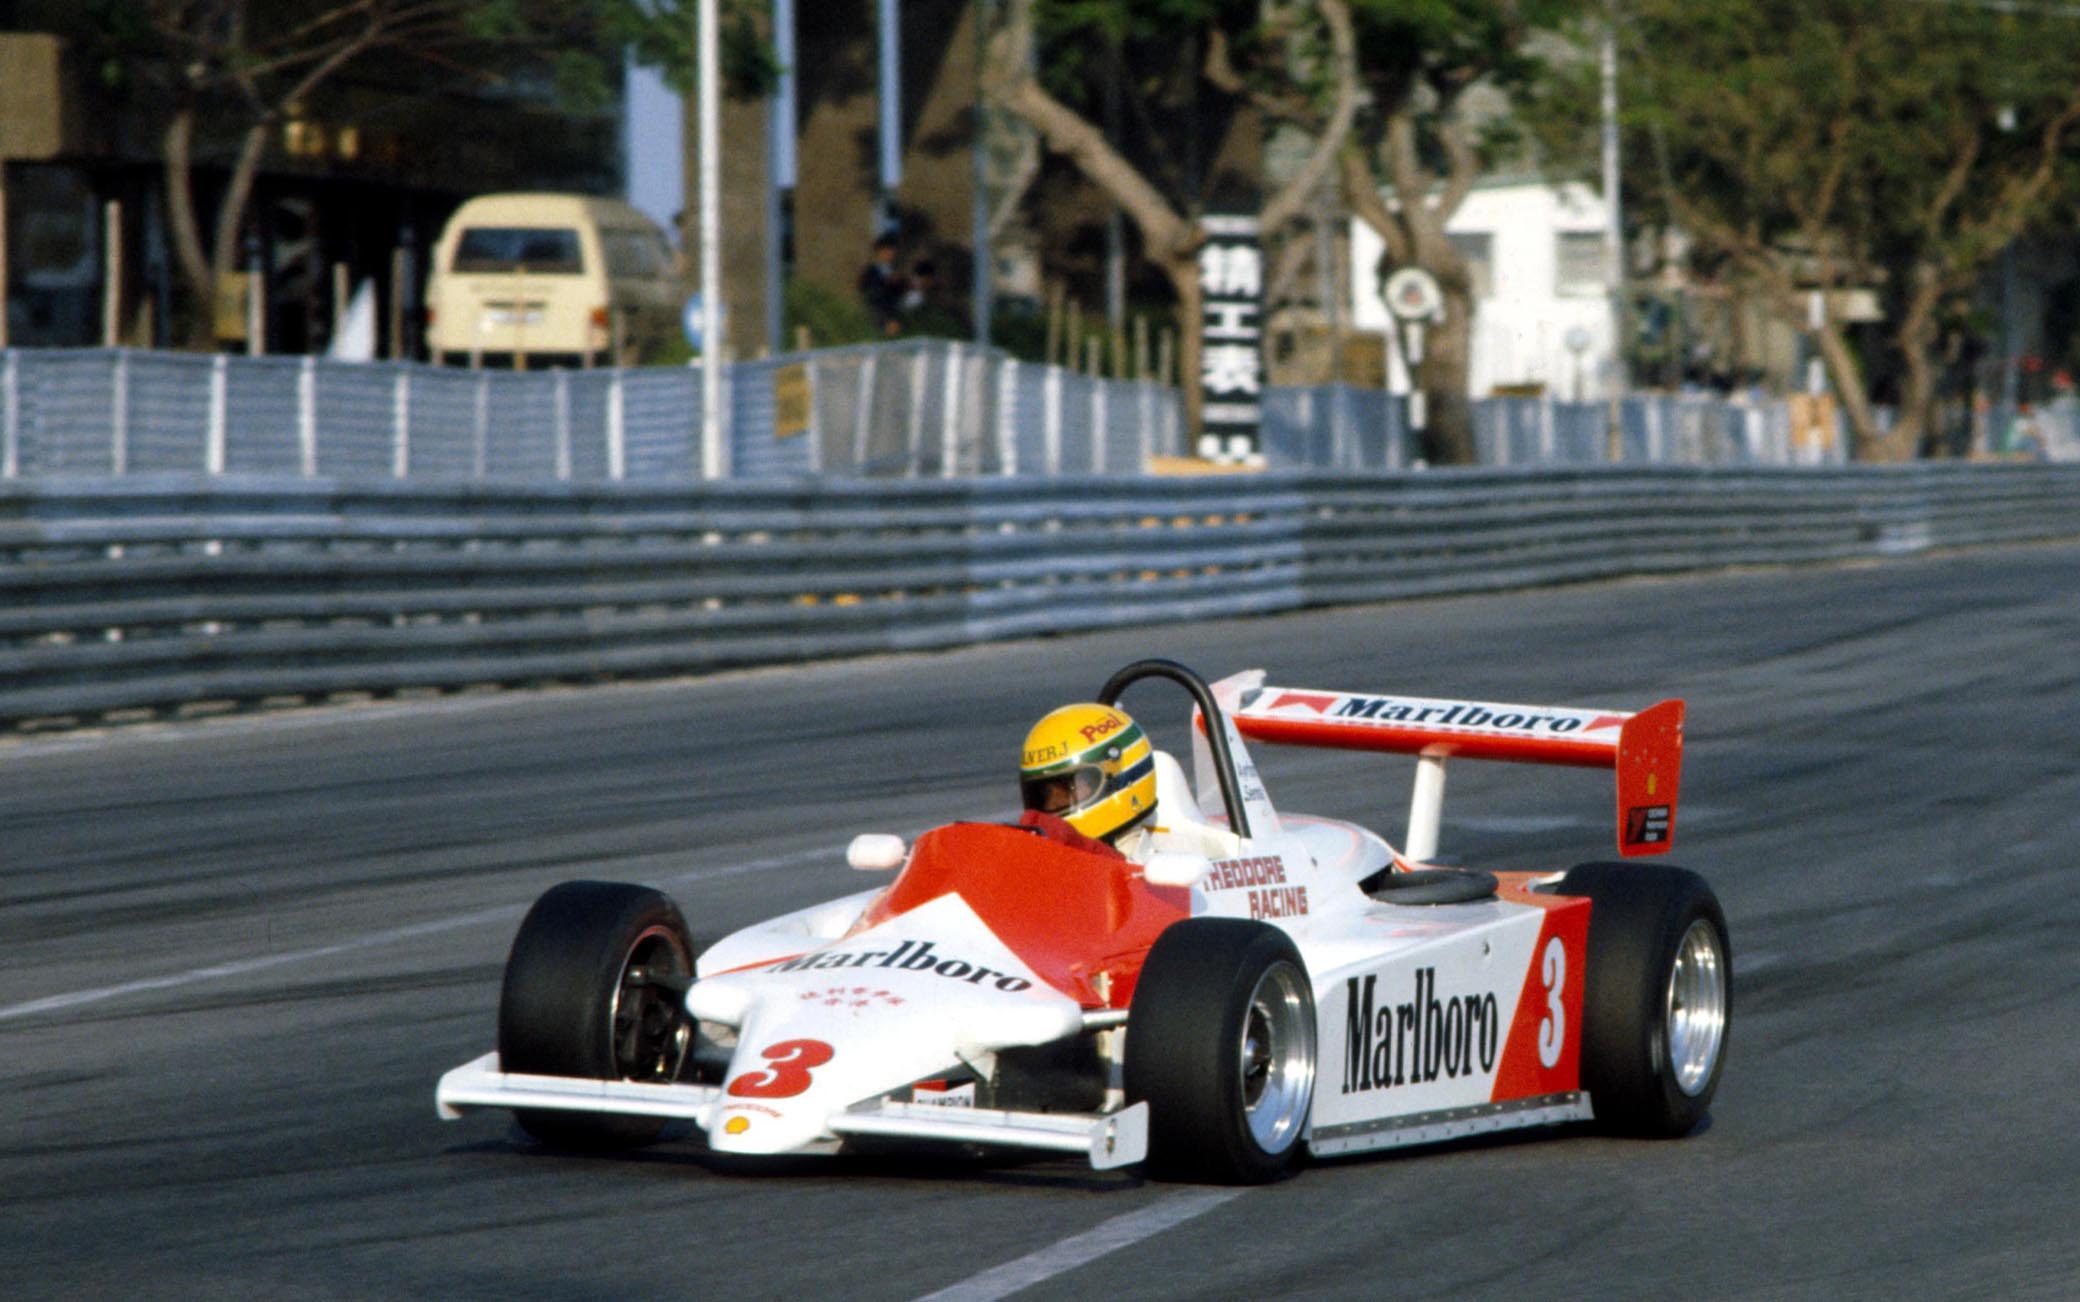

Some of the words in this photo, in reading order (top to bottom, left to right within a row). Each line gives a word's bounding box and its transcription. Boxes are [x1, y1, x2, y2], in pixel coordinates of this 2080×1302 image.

[1334, 697, 1583, 733] Marlboro
[1248, 886, 1309, 920] RACING
[766, 940, 1033, 993] Marlboro
[1342, 967, 1499, 1095] Marlboro
[1538, 936, 1566, 1069] 3
[727, 1038, 836, 1099] 3
